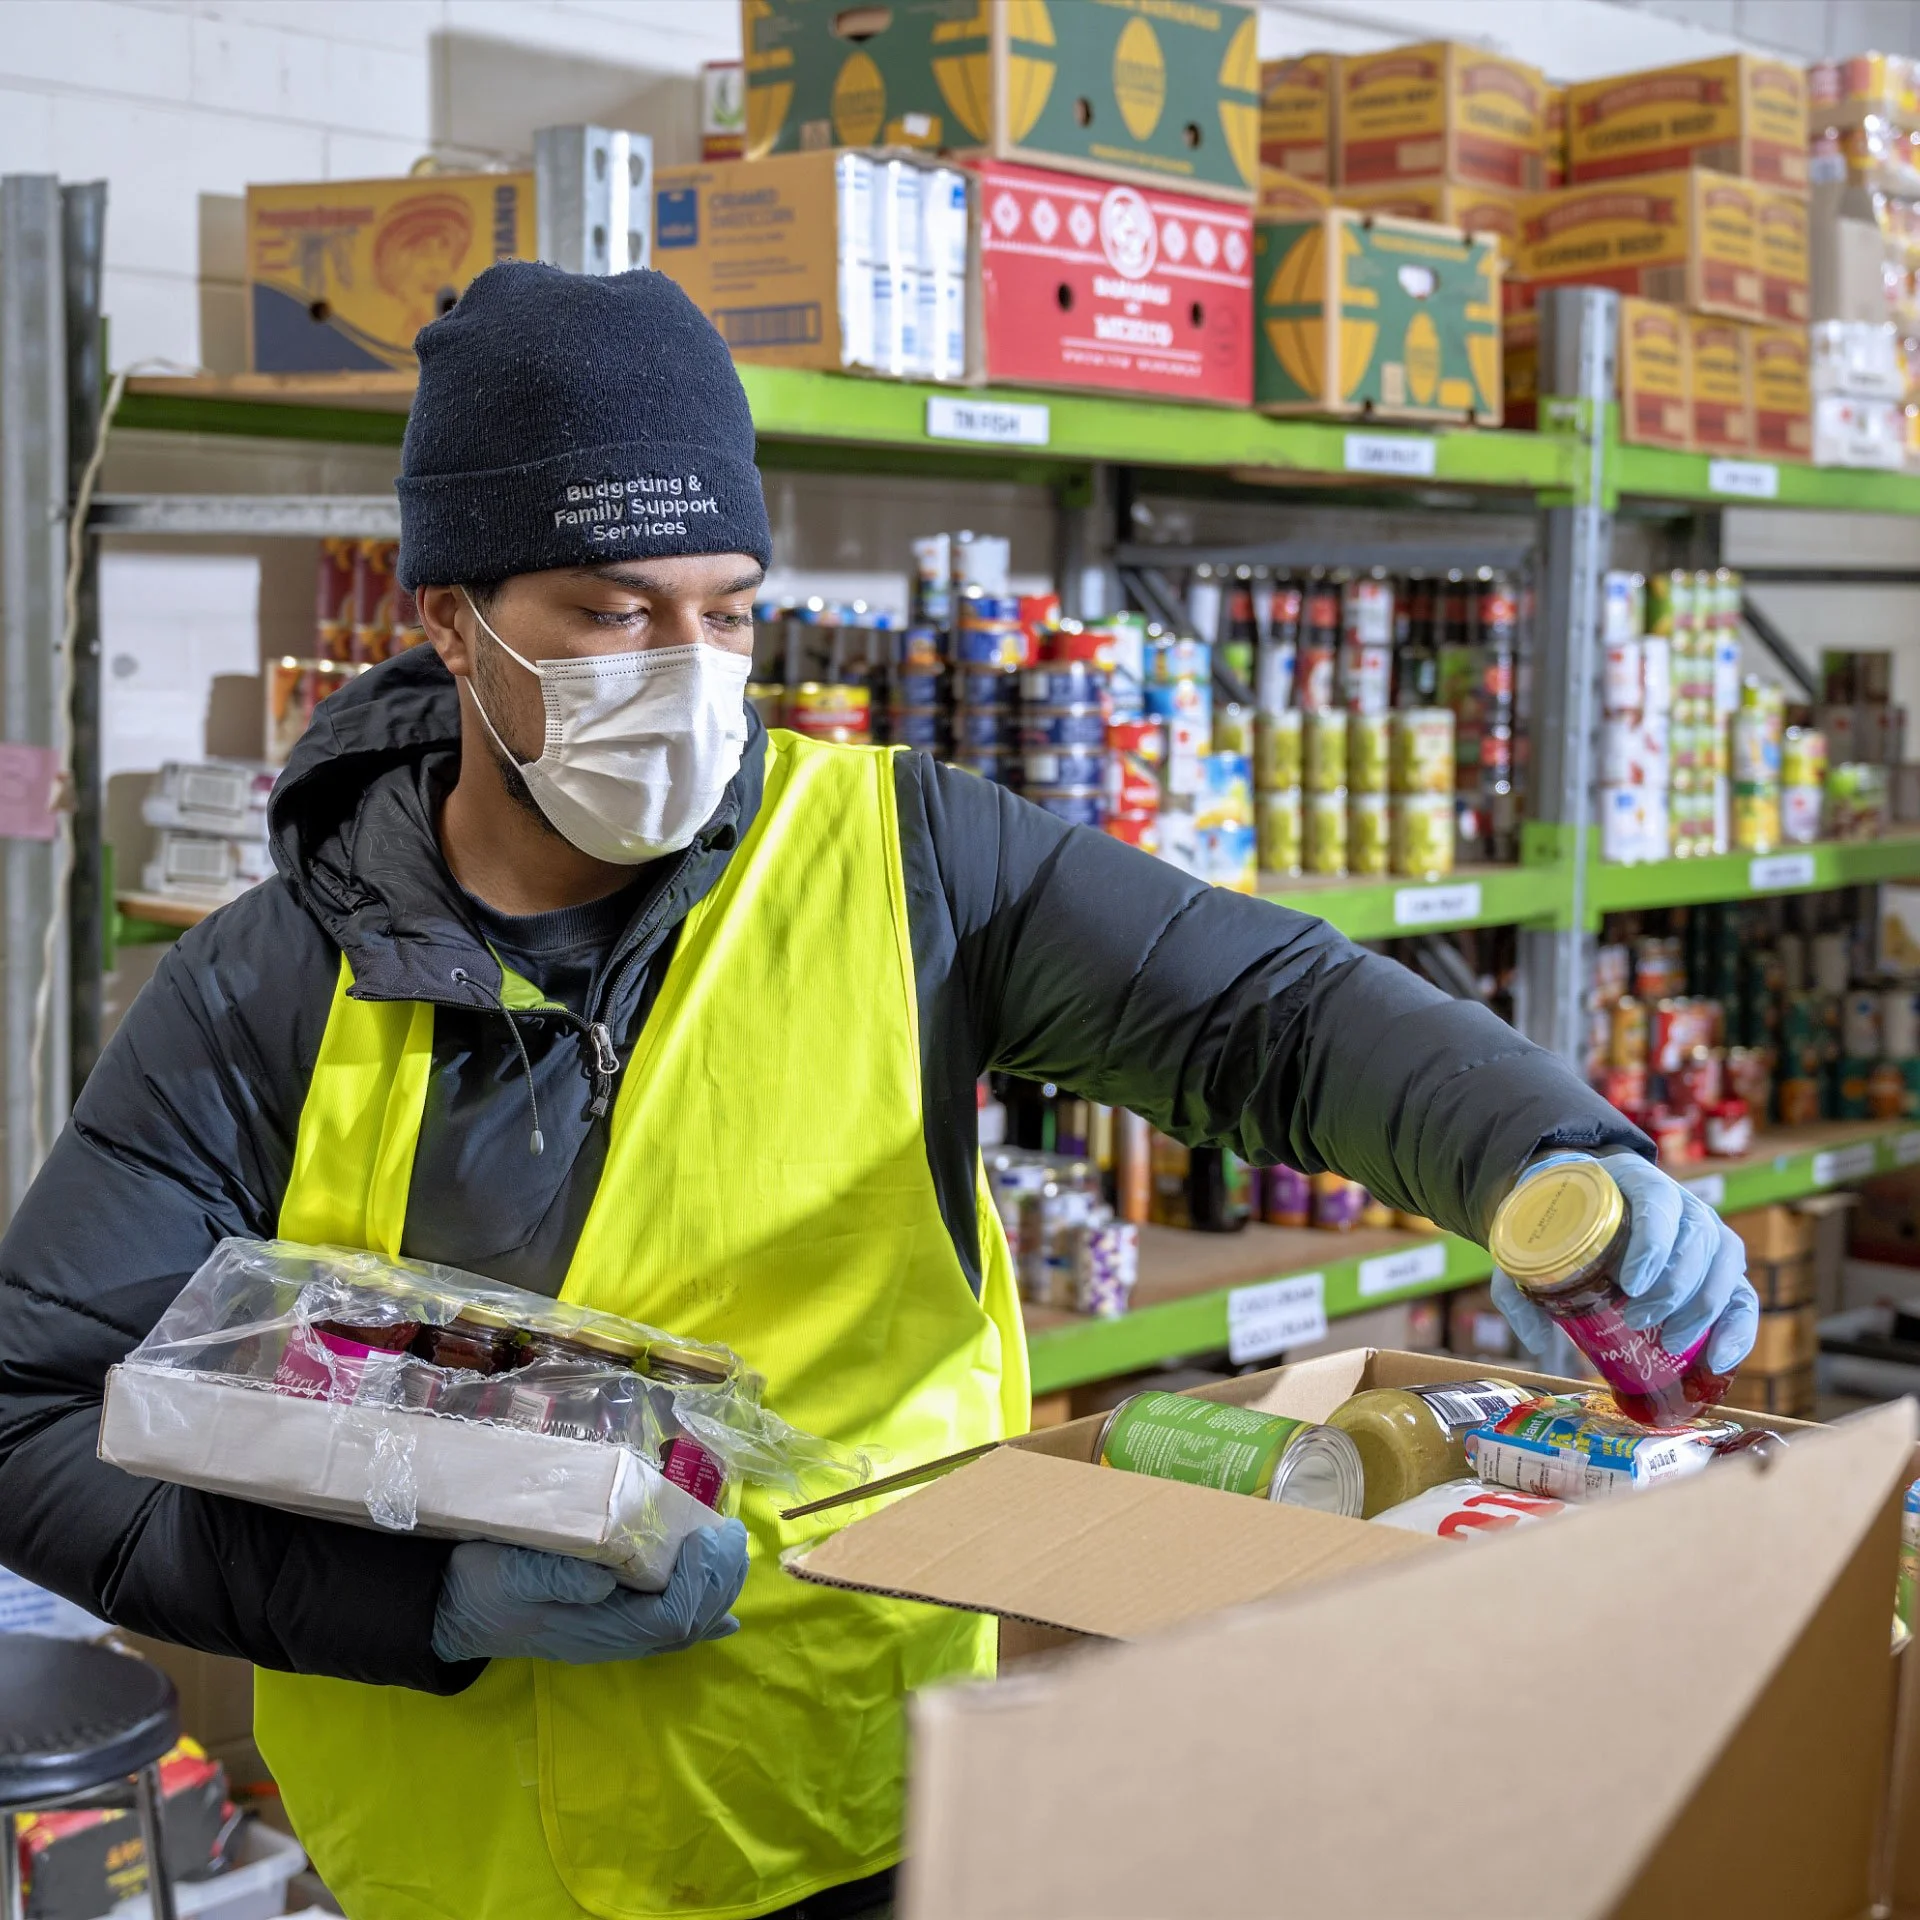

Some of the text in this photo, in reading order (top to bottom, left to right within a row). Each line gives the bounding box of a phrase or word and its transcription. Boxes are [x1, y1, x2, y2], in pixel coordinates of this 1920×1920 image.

[566, 474, 702, 501] Budgeting &
[554, 496, 719, 528] Family Support
[593, 517, 688, 541] Services
